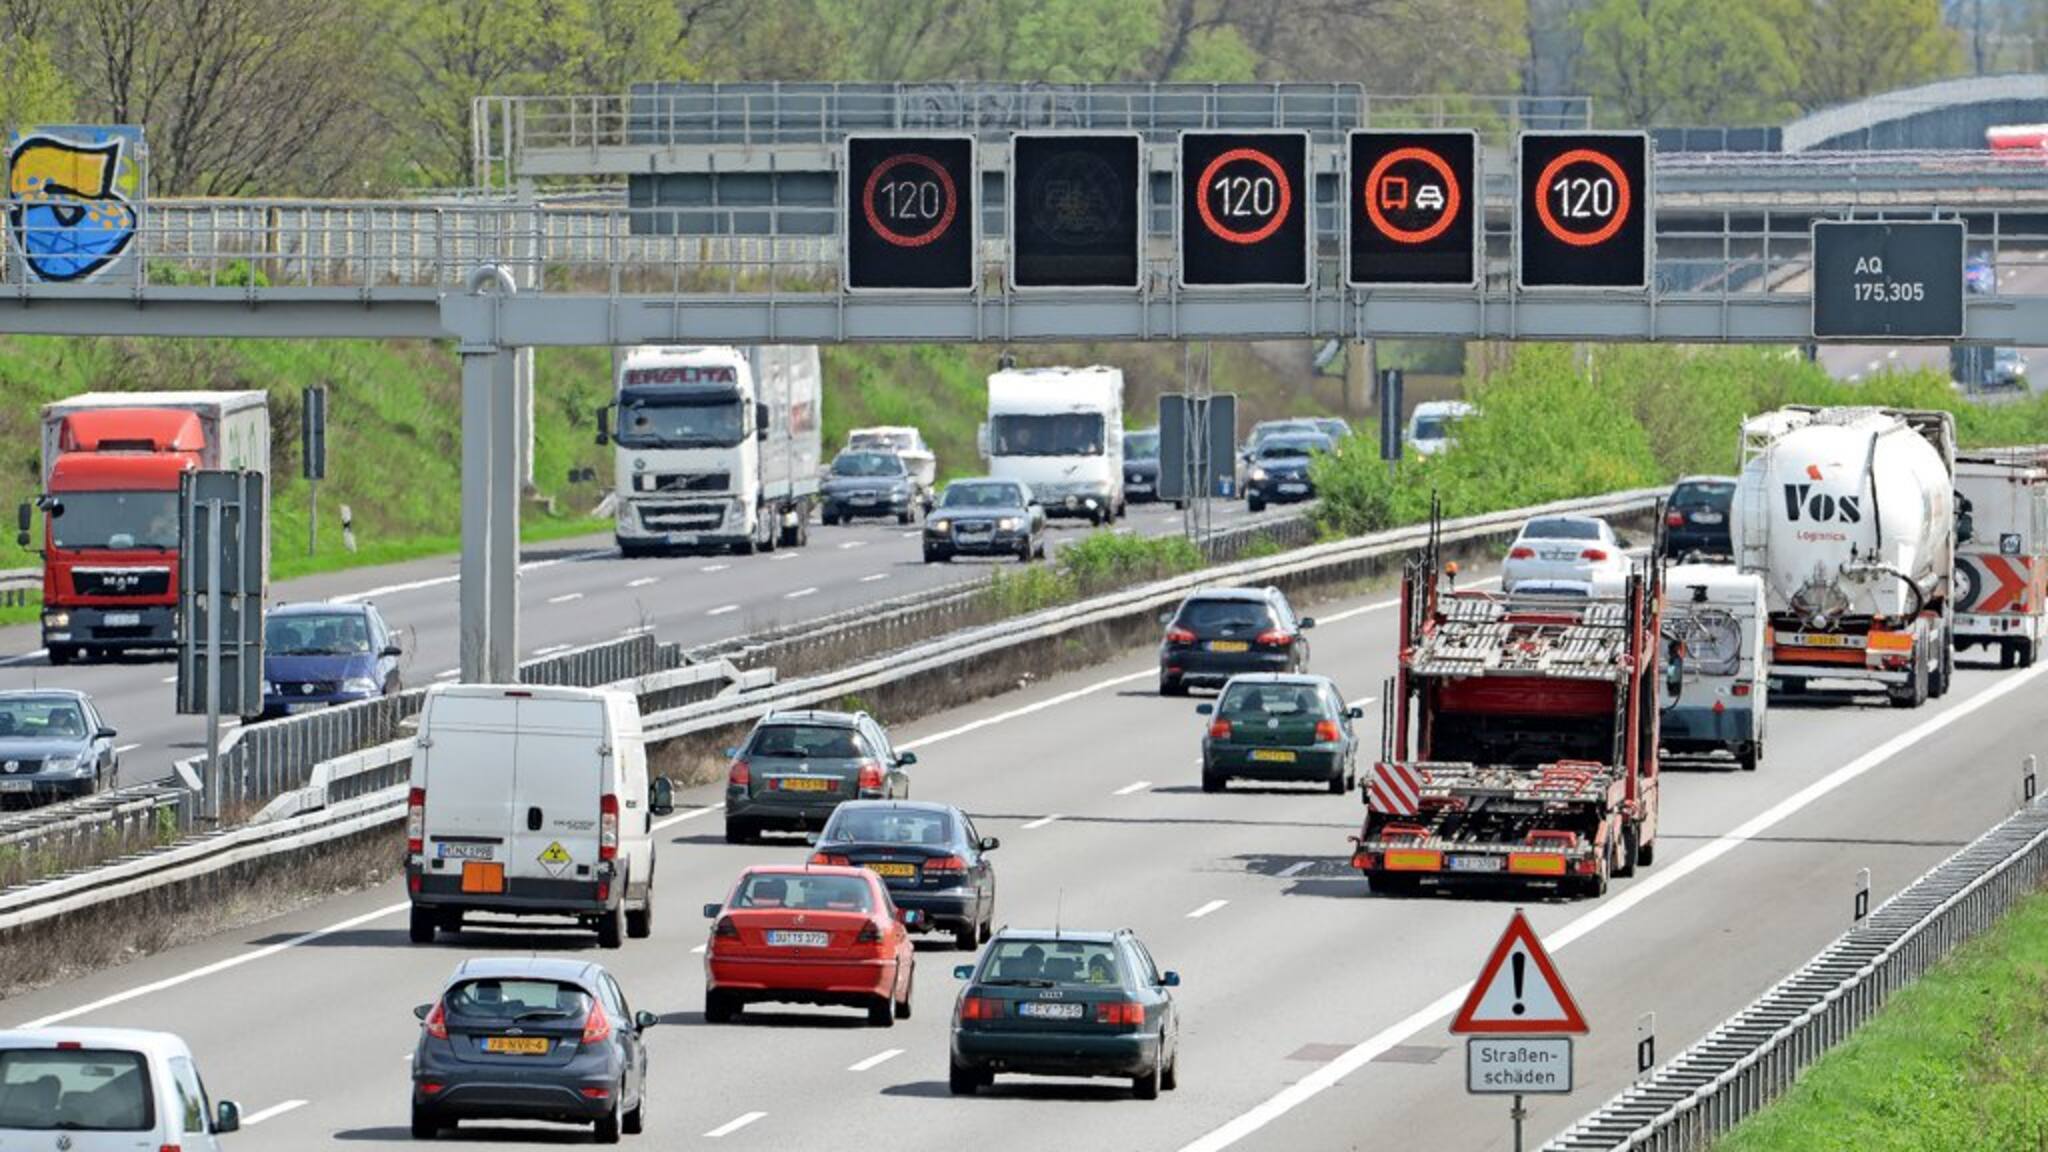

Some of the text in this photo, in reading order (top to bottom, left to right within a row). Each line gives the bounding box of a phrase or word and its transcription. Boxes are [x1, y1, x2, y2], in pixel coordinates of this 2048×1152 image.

[880, 180, 940, 219] 120
[1213, 176, 1274, 217] 120
[1553, 177, 1613, 218] 120
[1853, 256, 1883, 275] AQ
[1853, 282, 1925, 303] 175,305
[1480, 1047, 1558, 1063] Straßen-
[1484, 1069, 1555, 1085] schäden
